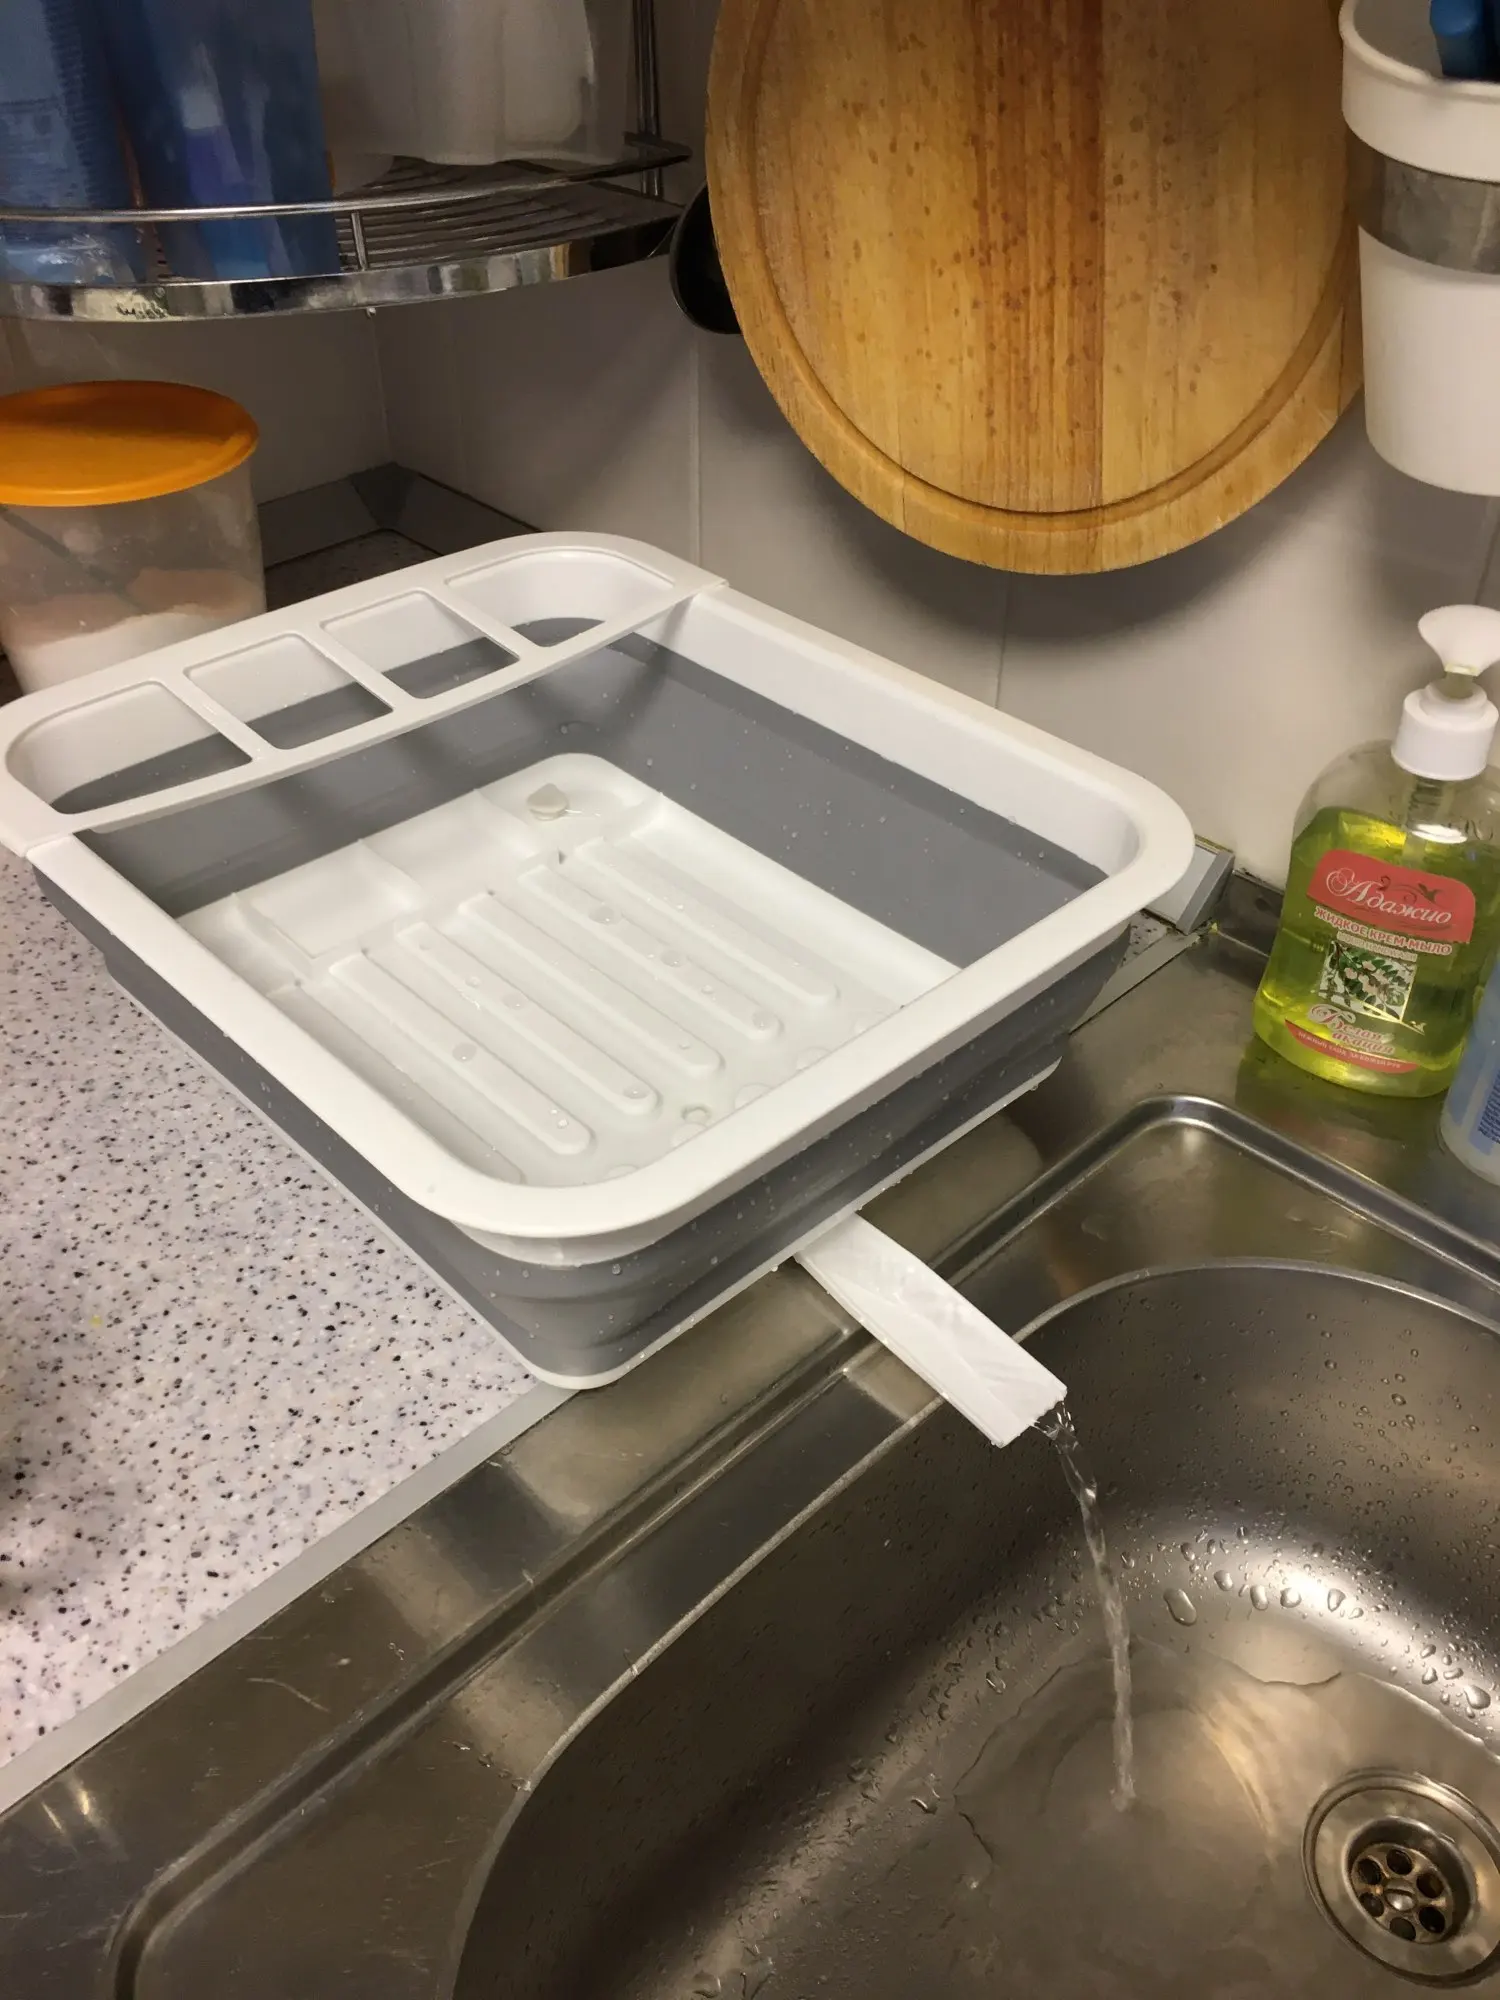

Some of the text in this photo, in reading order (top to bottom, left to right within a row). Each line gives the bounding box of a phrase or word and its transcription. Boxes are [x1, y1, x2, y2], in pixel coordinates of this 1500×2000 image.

[1326, 867, 1453, 924] Адажио
[1314, 906, 1369, 938] ЖИДКОЕ
[1368, 929, 1453, 955] КРЕМ-МЫЛО
